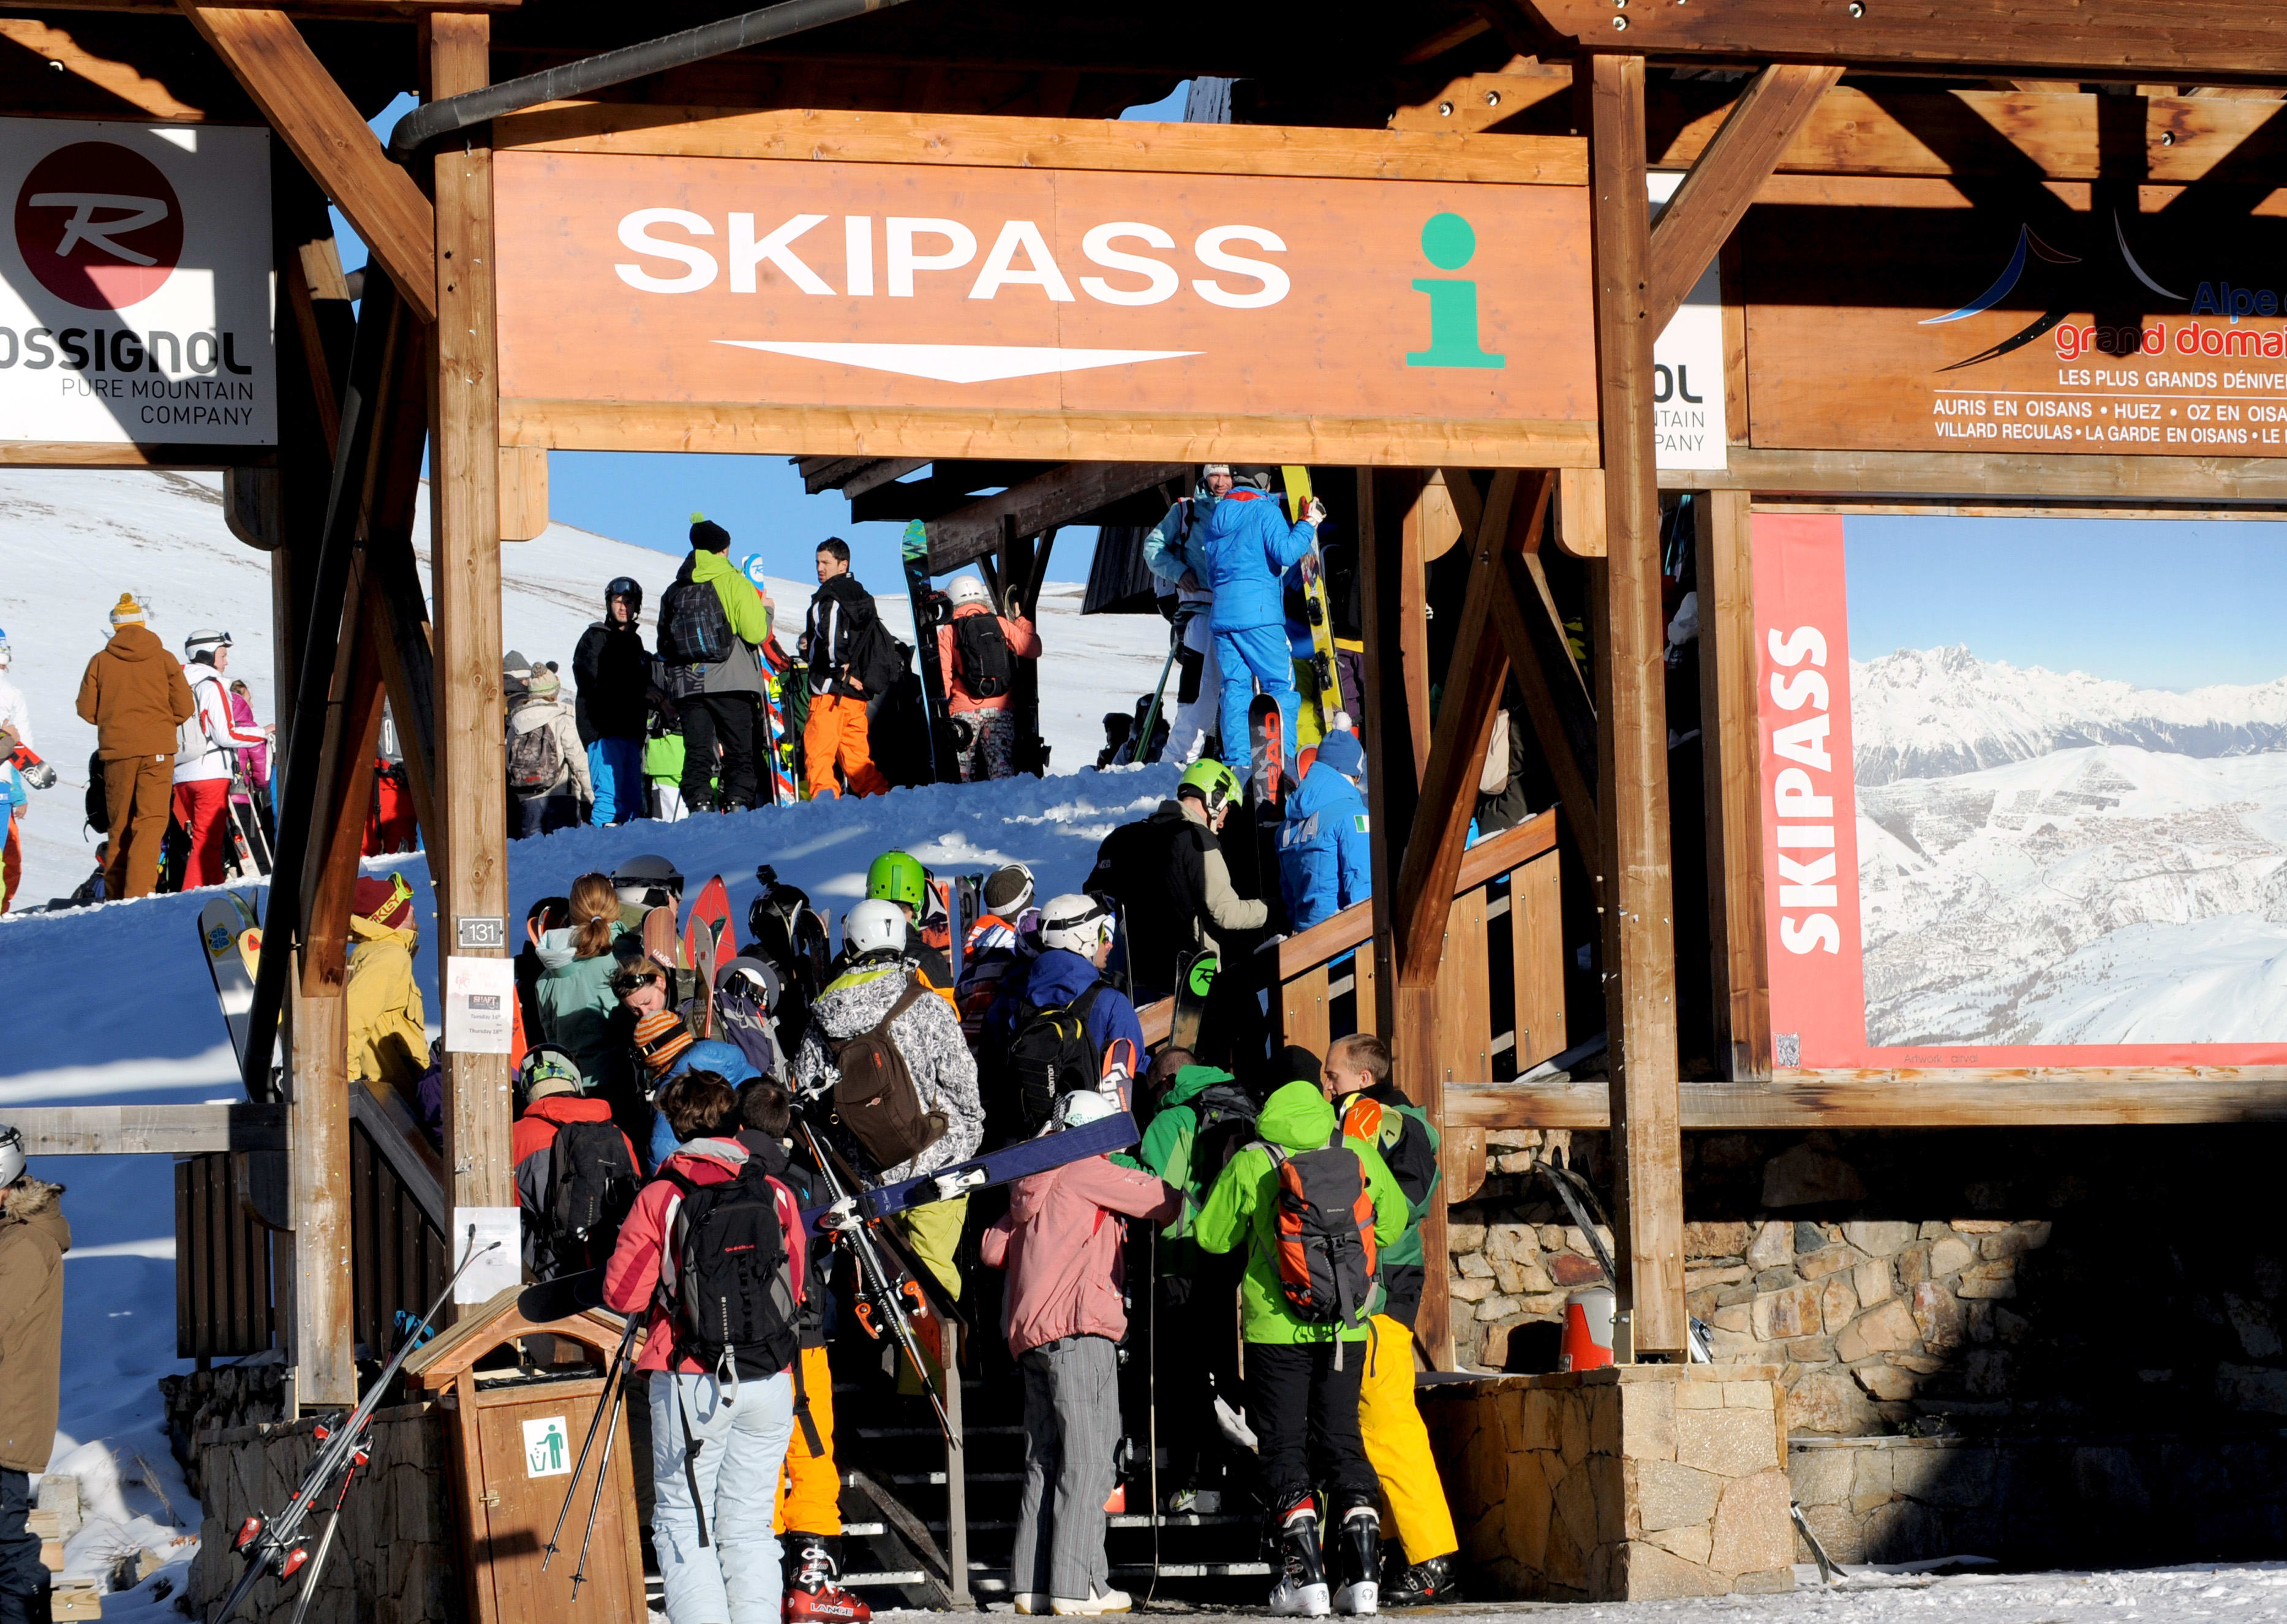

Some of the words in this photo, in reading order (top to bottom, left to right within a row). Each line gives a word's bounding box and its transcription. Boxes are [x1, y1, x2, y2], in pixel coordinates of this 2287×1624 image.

[614, 207, 1290, 308] SKIPASS
[2190, 281, 2278, 325] Alpe
[2055, 323, 2166, 361] grand
[62, 378, 124, 397] PURE
[132, 380, 253, 400] MOUNTAIN
[2059, 369, 2090, 386] LES
[2095, 370, 2139, 386] PLUS
[2146, 370, 2217, 388] GRANDS
[2223, 369, 2287, 389] DÉNIVE
[141, 405, 253, 426] COMPANY
[1933, 399, 1986, 416] AURIS
[1994, 400, 2018, 416] EN
[2026, 400, 2092, 418] OISANS
[2114, 403, 2161, 419] HUEZ
[2187, 404, 2211, 421] OZ
[2217, 405, 2239, 421] EN
[1935, 421, 1997, 438] VILLARD
[2002, 423, 2072, 440] RECULAS
[2085, 425, 2104, 441] LA
[2108, 426, 2160, 442] GARDE
[2167, 427, 2187, 443] EN
[2191, 427, 2248, 444] OISANS
[2263, 429, 2280, 444] LE
[1768, 626, 1841, 955] SKIPASS
[469, 923, 495, 942] 131
[810, 1601, 854, 1617] LANGE
